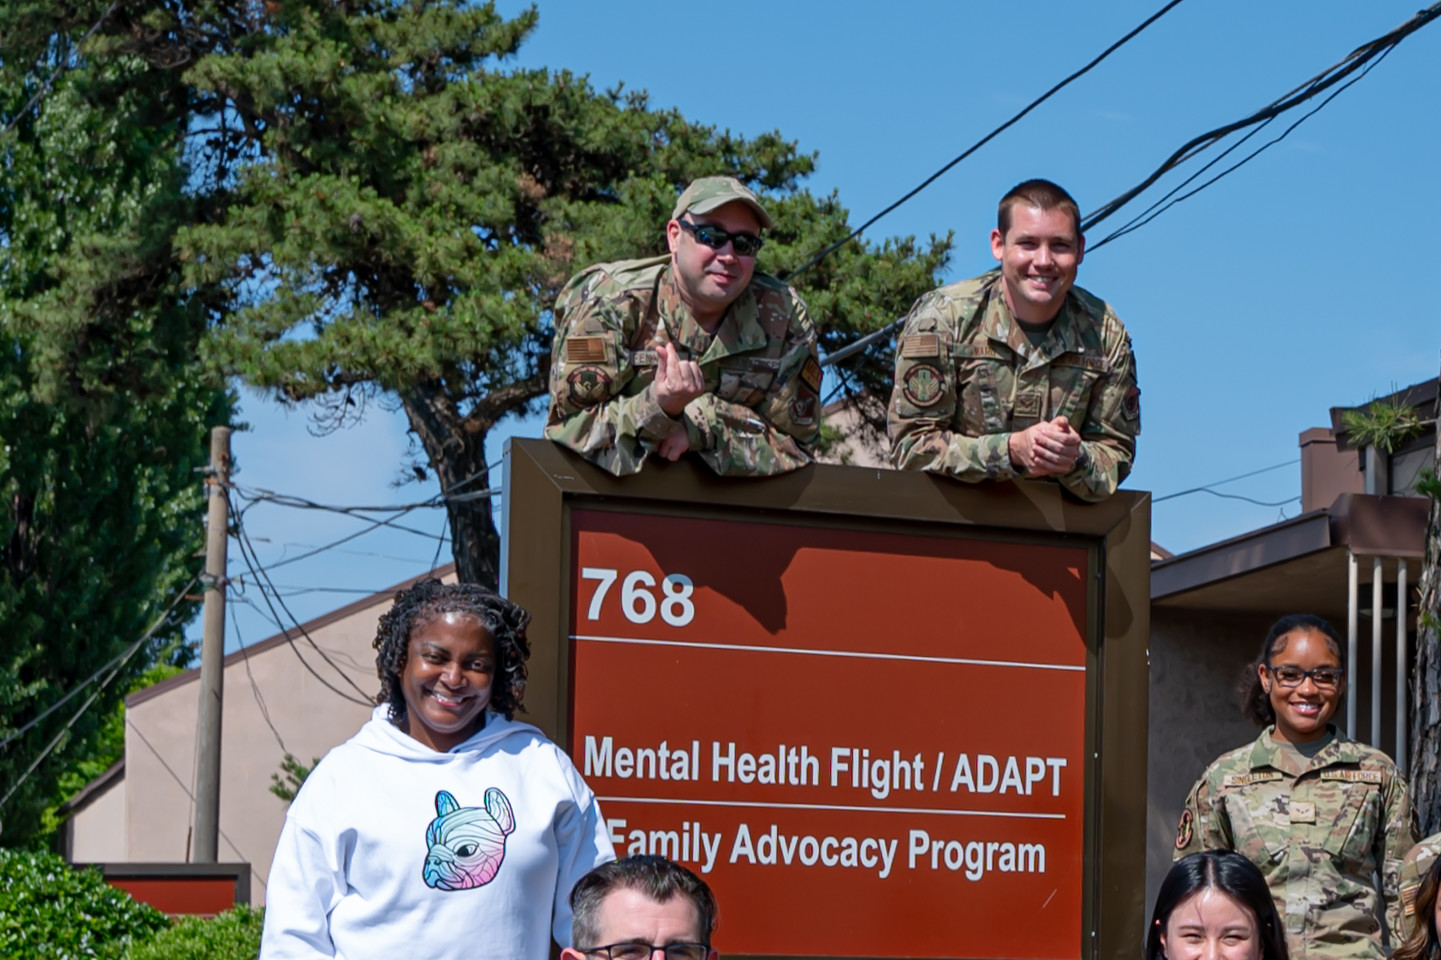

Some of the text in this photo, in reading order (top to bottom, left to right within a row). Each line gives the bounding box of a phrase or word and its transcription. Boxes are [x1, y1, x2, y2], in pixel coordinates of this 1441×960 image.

[581, 567, 695, 627] 768
[584, 735, 1067, 800] Mental Health Flight / ADAPT
[606, 818, 1046, 882] Family Advocacy Program
